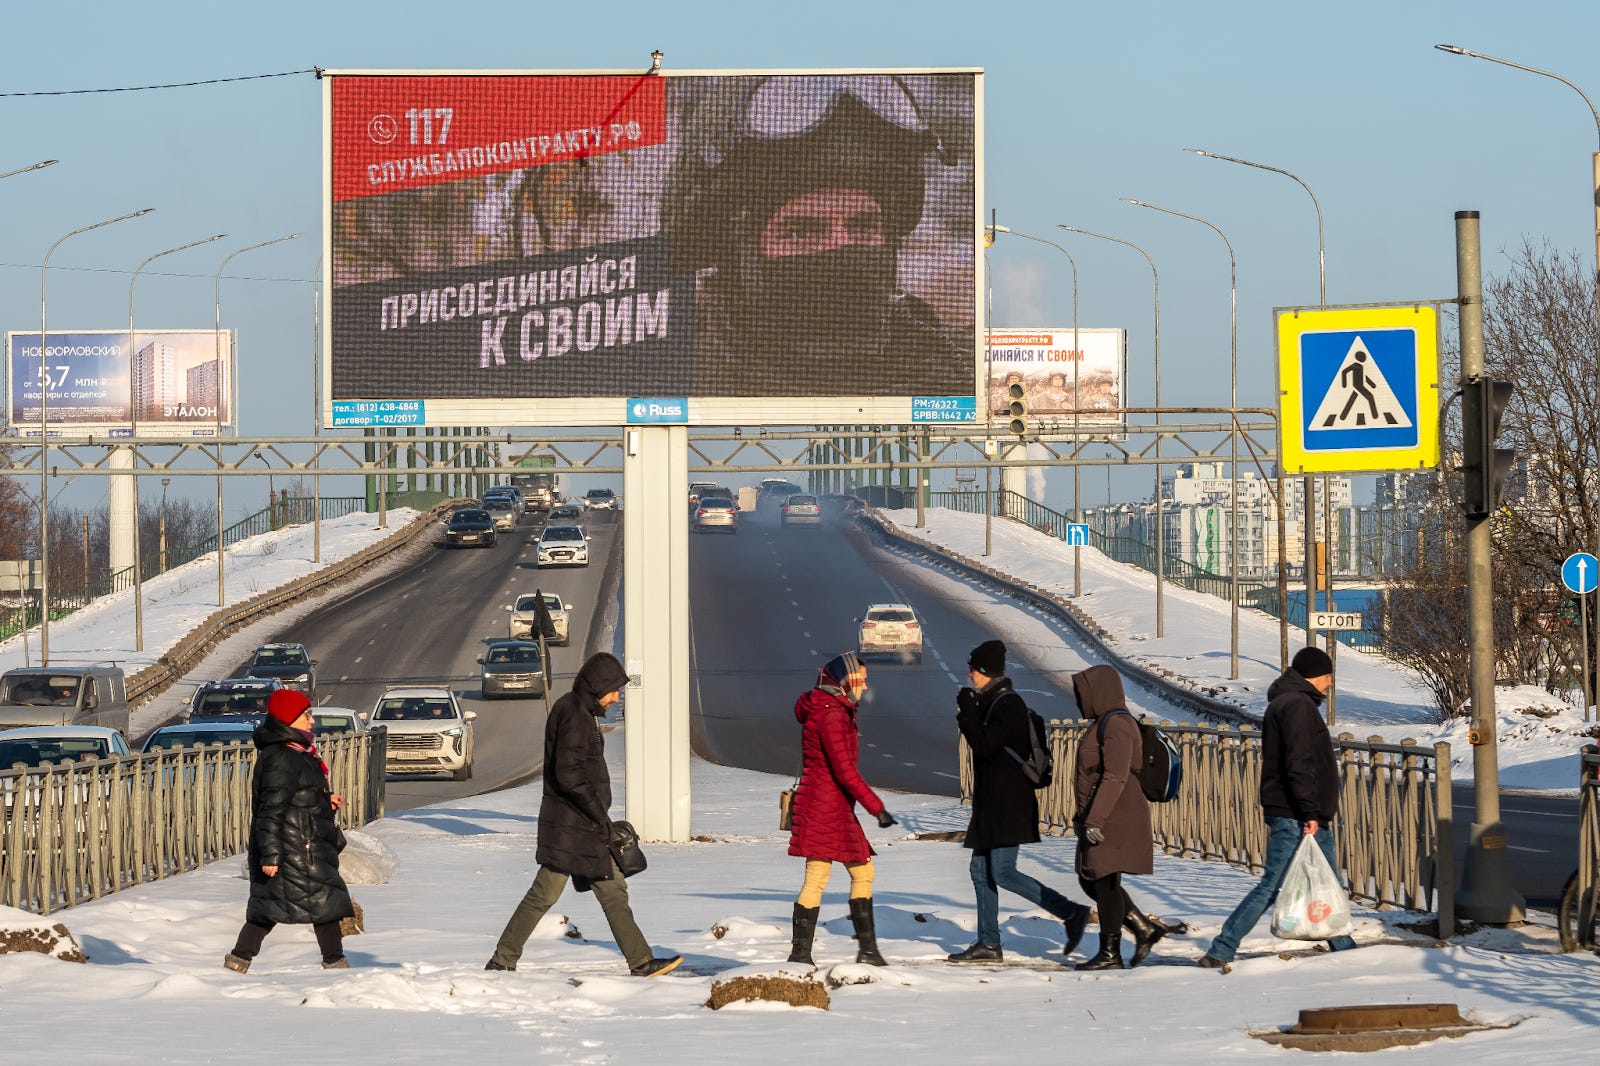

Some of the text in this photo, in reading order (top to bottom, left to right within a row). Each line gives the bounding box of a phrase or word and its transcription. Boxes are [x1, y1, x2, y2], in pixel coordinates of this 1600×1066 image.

[405, 107, 453, 145] 117
[367, 120, 642, 185] СЛУЖБАПОКОНТРАКТУ.РФ
[380, 253, 637, 331] ПРИСОЕДИНЯЙСЯ
[479, 288, 670, 368] К СВОИМ
[1037, 349, 1045, 362] К
[37, 365, 70, 391] 5,7
[23, 391, 62, 400] квариры
[163, 406, 217, 417] ЭТАЛОН
[357, 402, 378, 412] (812)
[379, 402, 419, 411] 438-4848
[649, 404, 682, 416] Russ
[334, 416, 373, 425] договор:
[1317, 615, 1354, 627] СТОП
